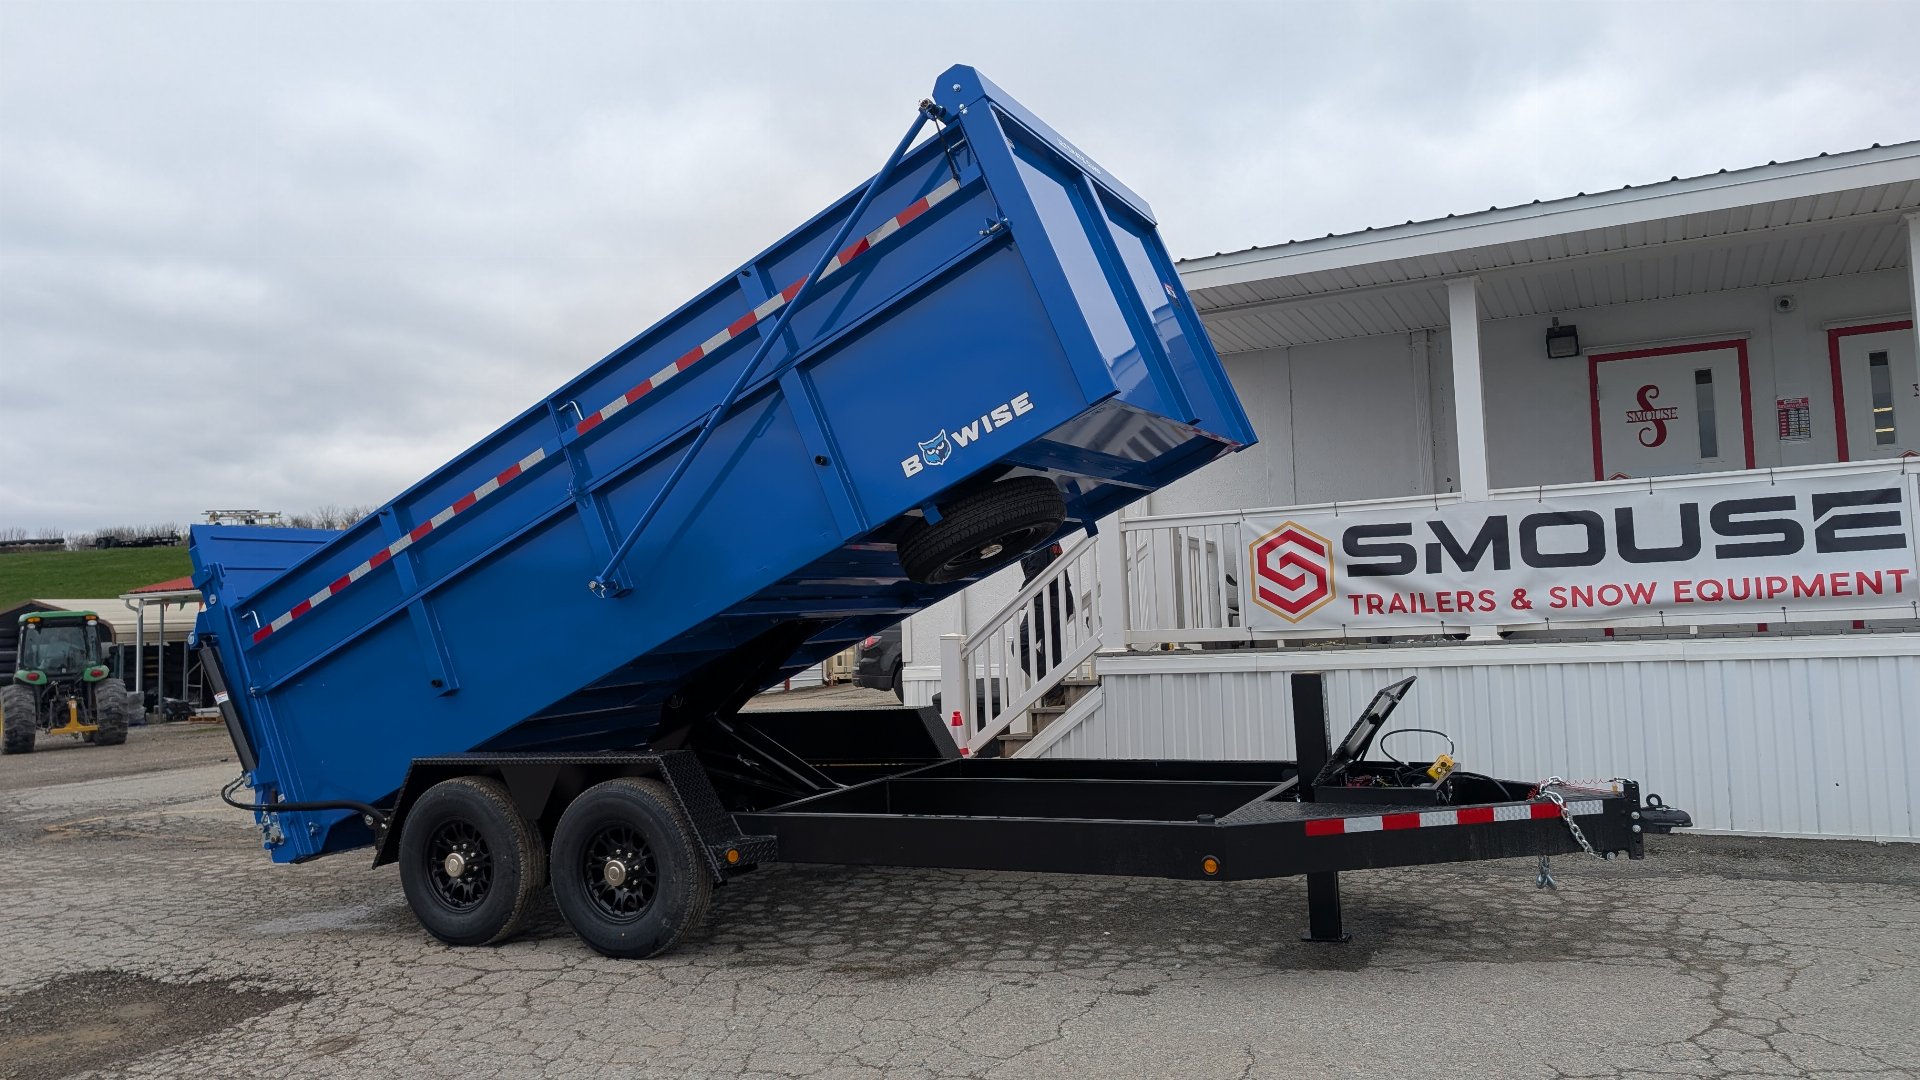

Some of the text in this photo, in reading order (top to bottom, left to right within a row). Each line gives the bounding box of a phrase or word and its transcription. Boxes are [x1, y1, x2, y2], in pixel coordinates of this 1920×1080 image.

[1626, 408, 1678, 422] SMOUSE
[1342, 487, 1908, 578] SMOUSE
[1347, 568, 1909, 616] TRAILERS & SNOW EQUIPMENT
